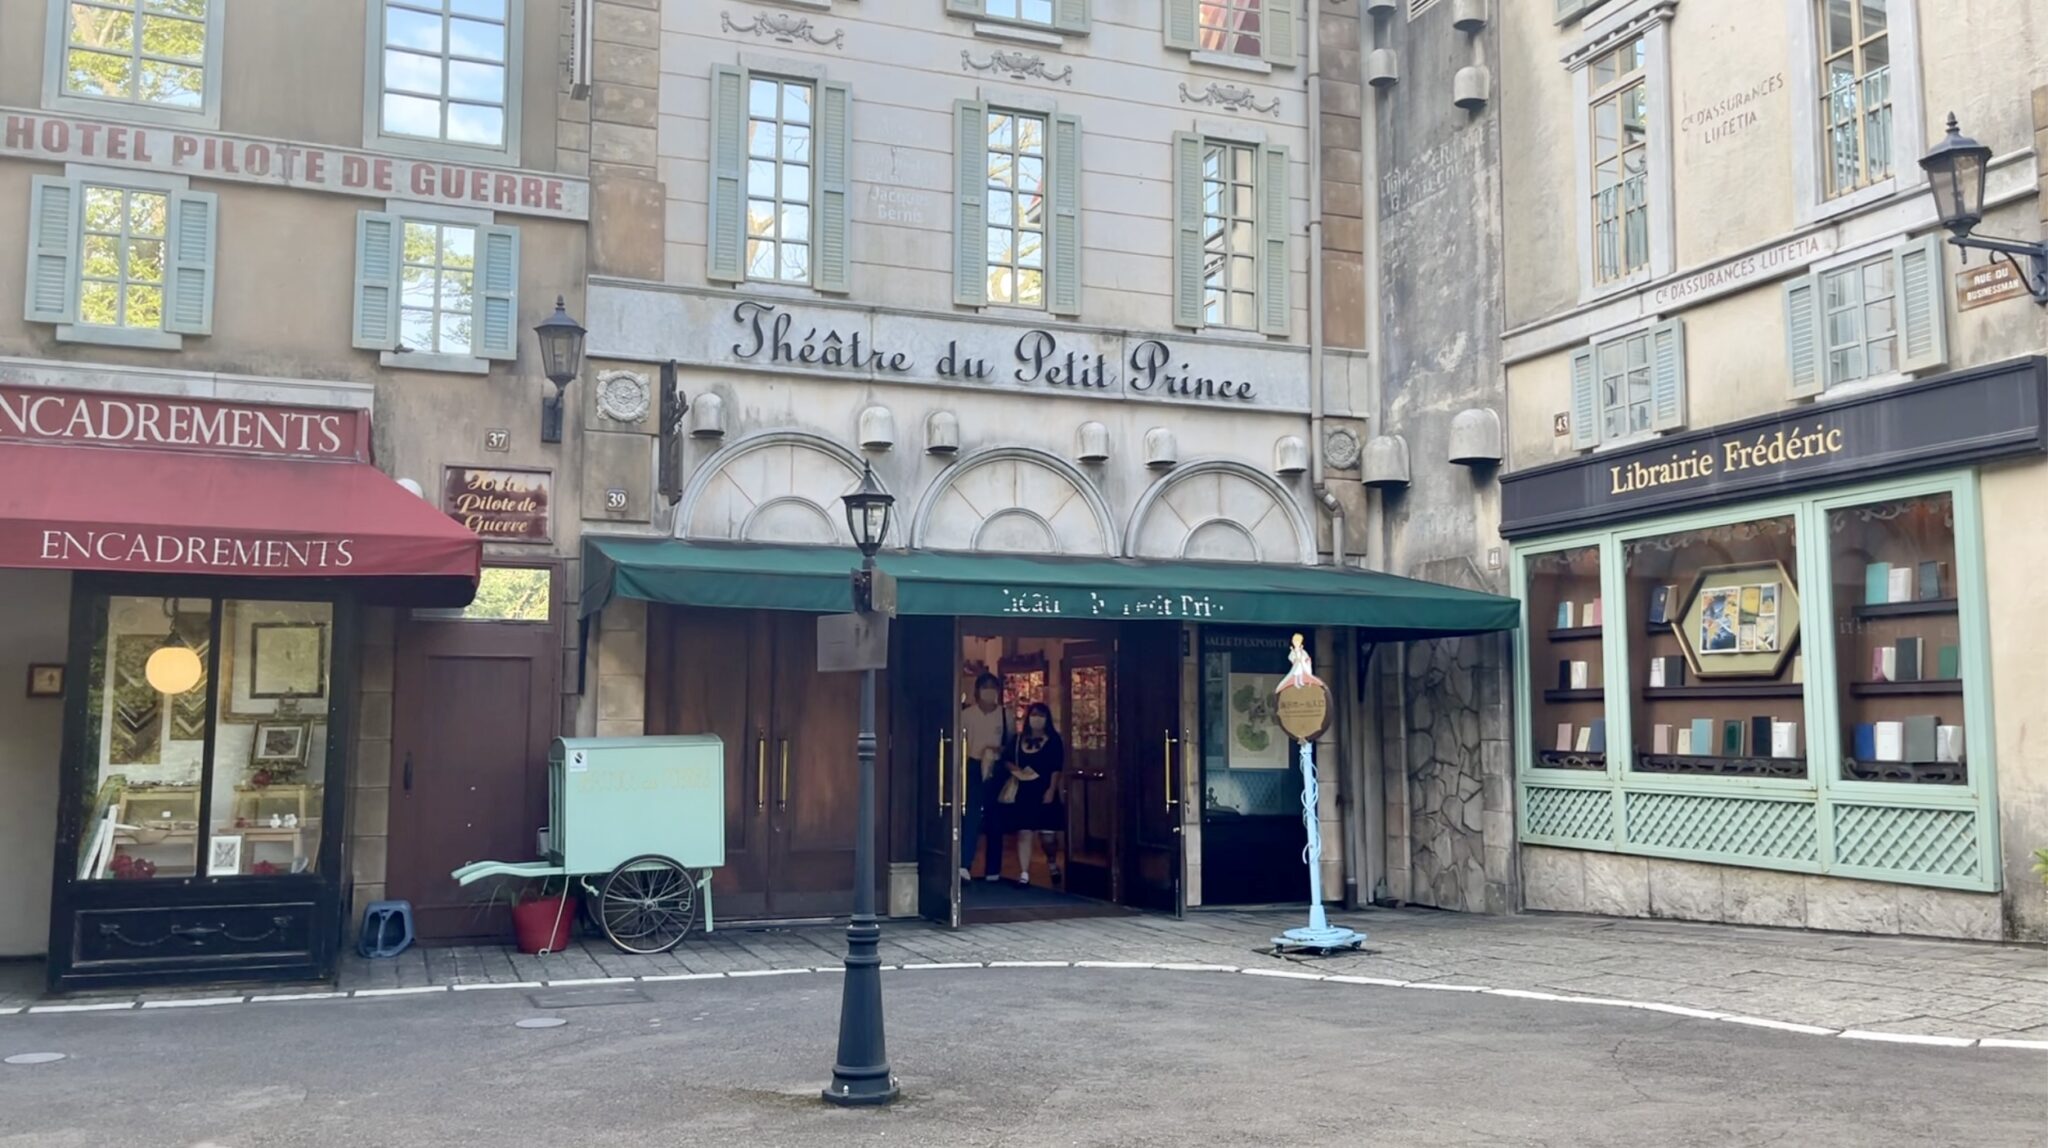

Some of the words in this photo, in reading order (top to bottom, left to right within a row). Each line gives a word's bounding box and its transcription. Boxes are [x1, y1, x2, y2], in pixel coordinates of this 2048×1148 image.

[5, 115, 152, 163] HOTEL
[172, 134, 325, 183] PILOTE
[342, 155, 393, 191] DE
[410, 163, 564, 210] GUERRE
[1671, 257, 1756, 300] D'ASSURANCES
[1761, 236, 1819, 270] LUTETIA
[1974, 271, 1993, 286] RUE
[1995, 267, 2009, 280] DU
[1966, 278, 2019, 301] BUSINESSMAN
[733, 301, 914, 372] Théâtre
[936, 340, 994, 379] du
[1014, 330, 1116, 388] Petit
[1129, 340, 1256, 399] Prince
[0, 394, 341, 453] NCADREMENTS
[1556, 415, 1568, 431] 43
[488, 433, 506, 447] 37
[1610, 450, 1714, 494] Librairie
[1723, 424, 1842, 473] Frédéric
[457, 493, 516, 514] Pilote
[517, 497, 537, 513] de
[607, 493, 625, 508] 39
[465, 514, 528, 534] Guerre
[40, 530, 353, 568] ENCADREMENTS
